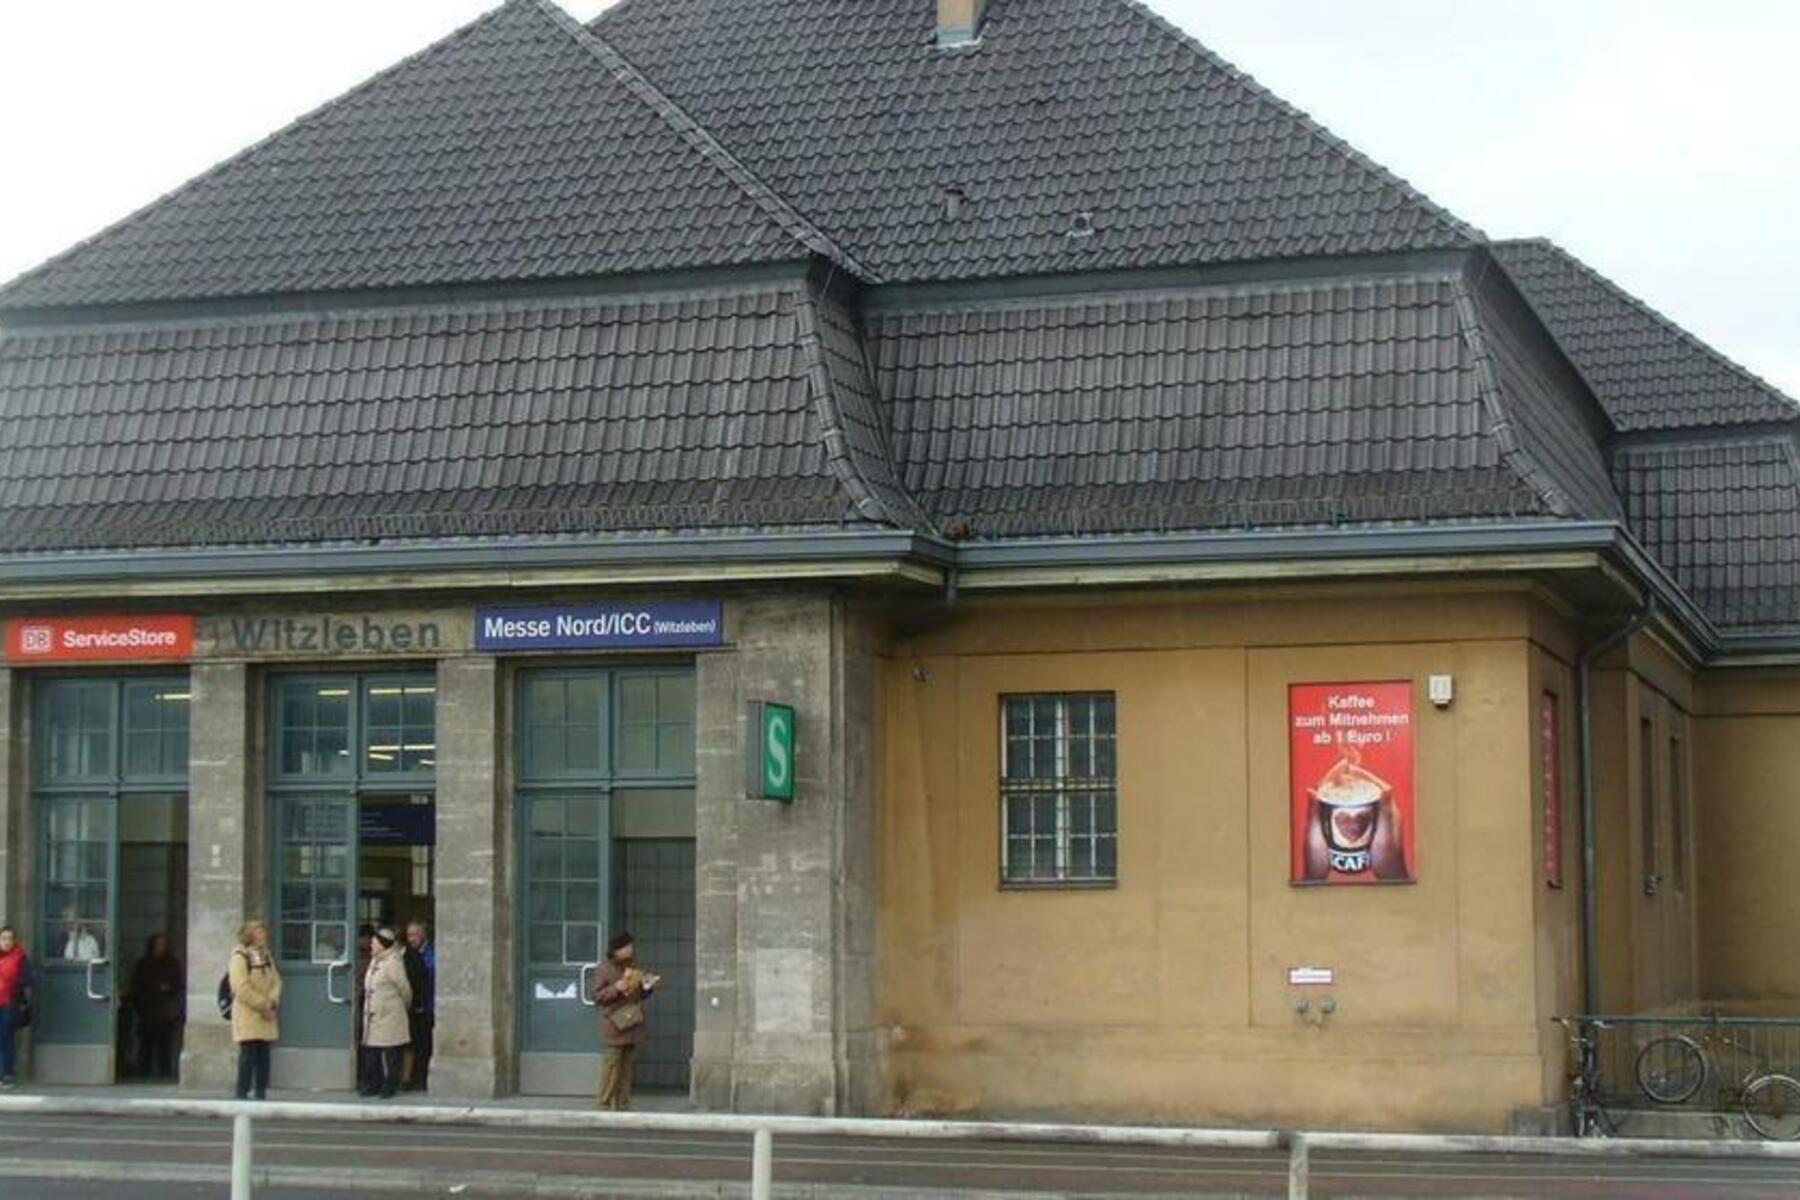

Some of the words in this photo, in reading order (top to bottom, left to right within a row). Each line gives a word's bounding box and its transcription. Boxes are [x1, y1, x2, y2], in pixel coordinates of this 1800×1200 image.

[231, 616, 440, 650] Witzleben
[484, 616, 551, 638] Messe
[555, 611, 651, 636] Nord/ICC
[653, 619, 717, 635] (Witzleben)
[63, 627, 178, 649] ServiceStore
[1328, 695, 1375, 709] Kaffee
[1295, 716, 1325, 727] zum
[1329, 712, 1409, 726] Mitnehmen
[1313, 731, 1332, 744] ab
[1336, 730, 1343, 742] 1
[1347, 729, 1382, 743] Euro
[767, 716, 786, 788] S
